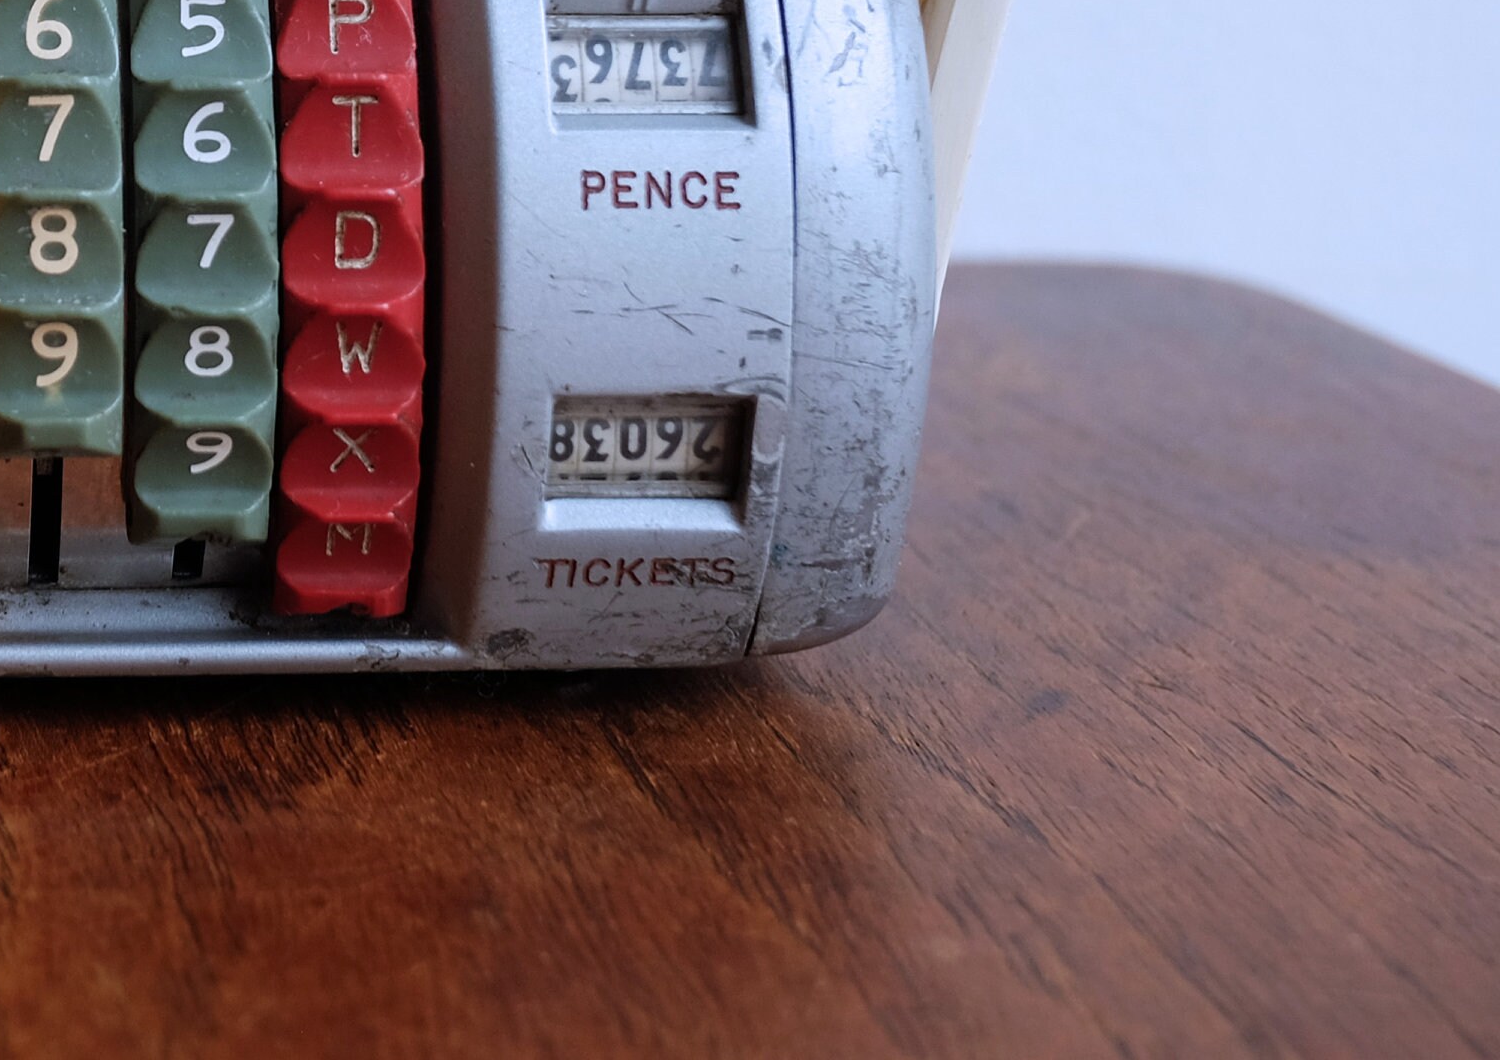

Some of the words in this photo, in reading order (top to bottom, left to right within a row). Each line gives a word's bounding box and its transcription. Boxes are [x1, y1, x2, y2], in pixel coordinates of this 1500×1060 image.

[28, 95, 75, 162] 7
[183, 102, 232, 163] 6
[332, 96, 378, 158] T
[581, 169, 741, 210] PENCE
[29, 206, 79, 274] 8
[186, 214, 234, 268] 7
[334, 210, 381, 269] D
[31, 322, 79, 388] 9
[184, 326, 233, 377] 8
[336, 321, 382, 375] W
[185, 431, 233, 474] 9
[330, 427, 376, 472] X
[550, 417, 721, 463] 26038
[326, 522, 369, 556] M
[538, 557, 736, 588] TICKETS
